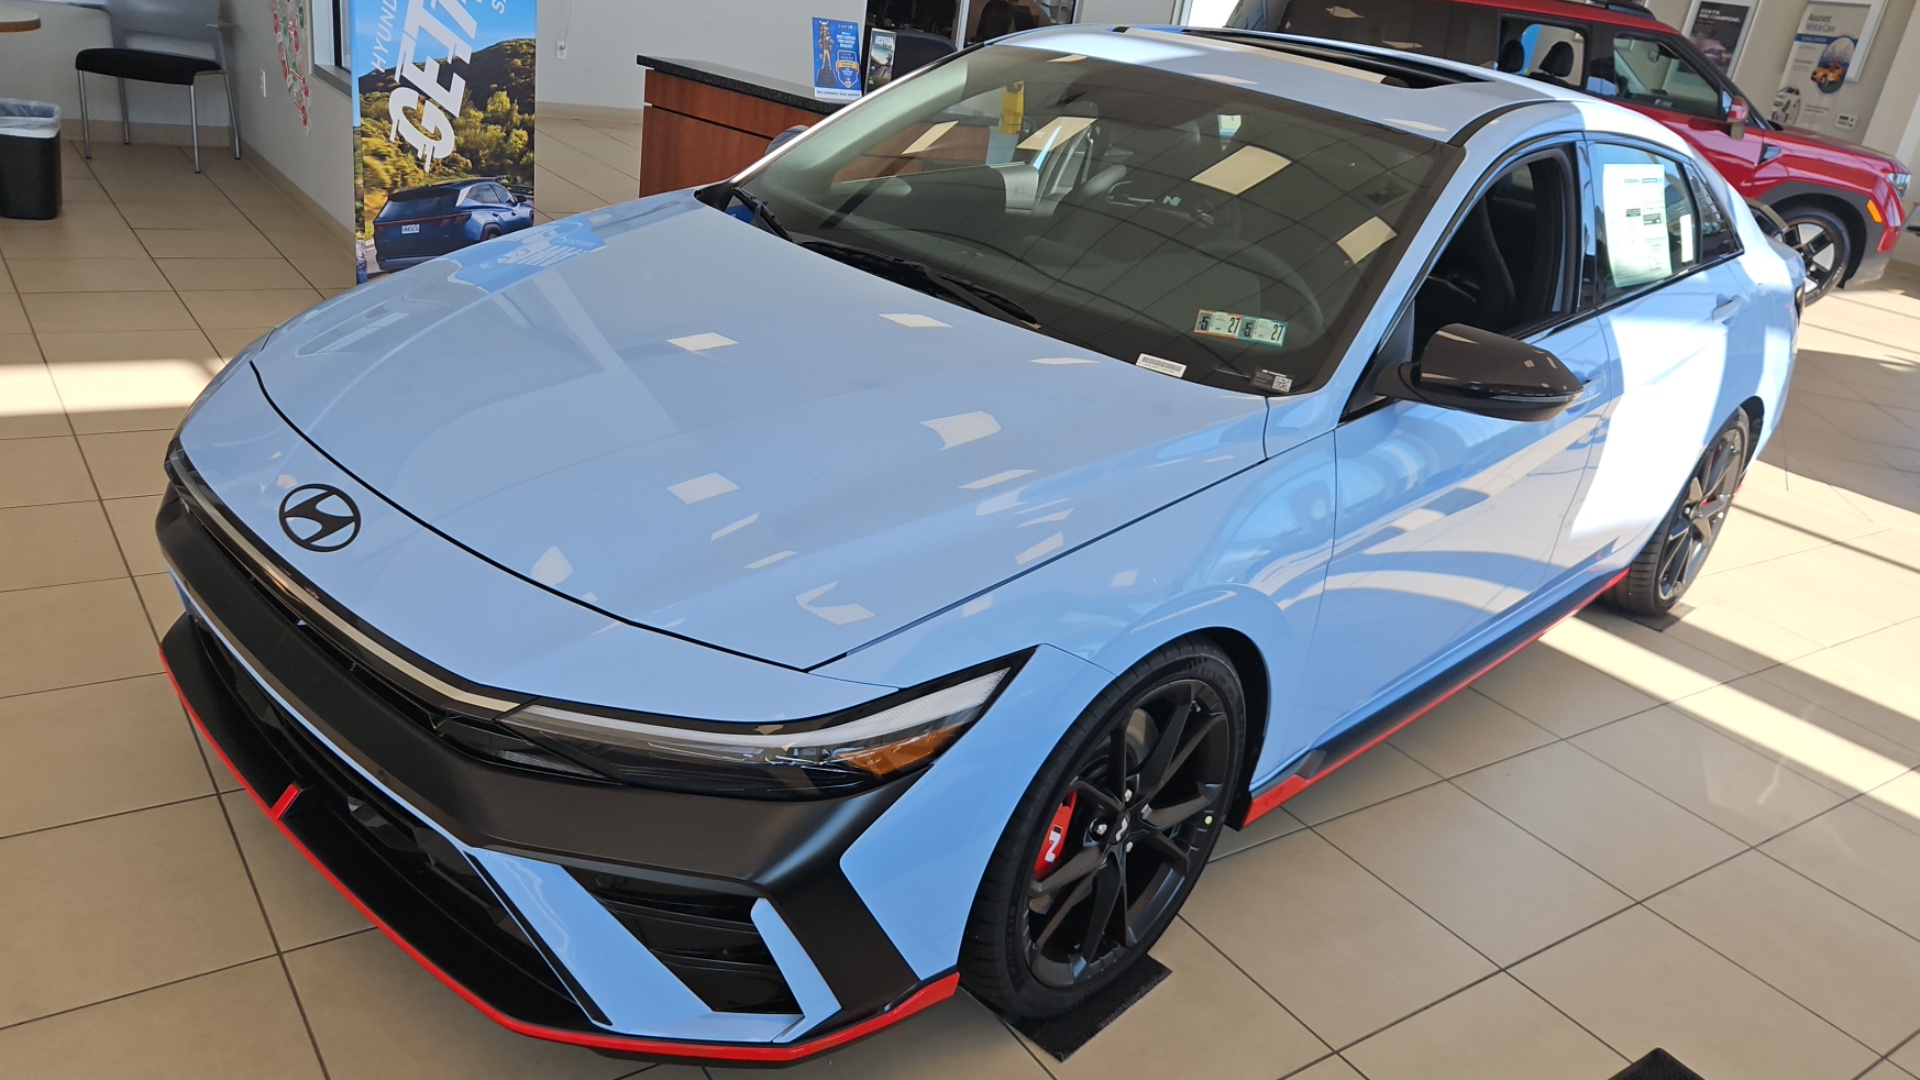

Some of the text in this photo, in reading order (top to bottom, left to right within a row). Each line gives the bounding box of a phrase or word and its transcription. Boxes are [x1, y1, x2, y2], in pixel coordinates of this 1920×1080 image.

[1200, 316, 1209, 331] 5
[1227, 317, 1240, 335] 27
[1244, 322, 1253, 337] 5
[1270, 324, 1283, 342] 27
